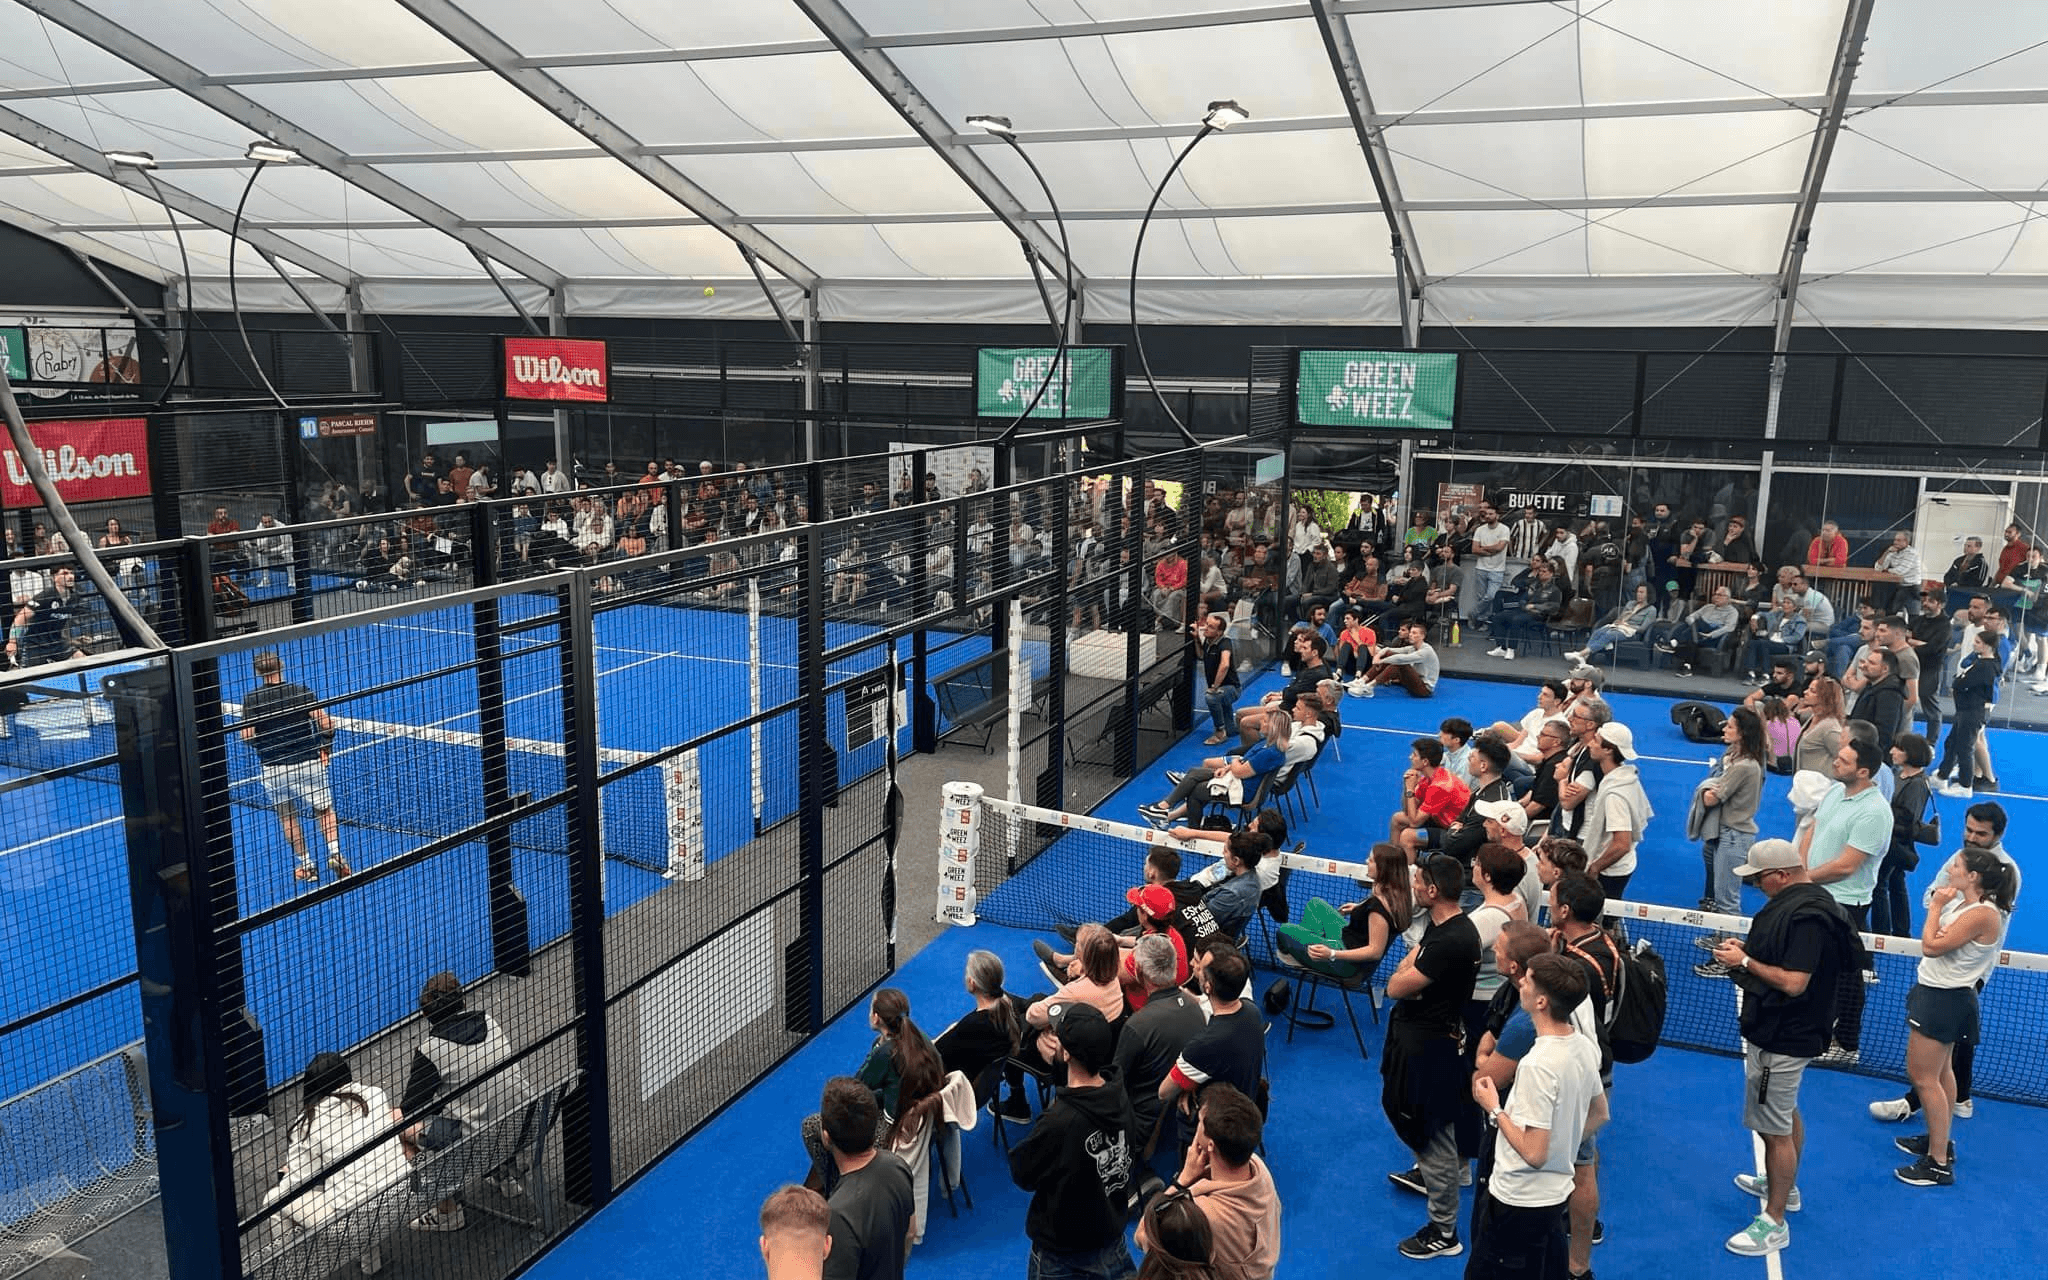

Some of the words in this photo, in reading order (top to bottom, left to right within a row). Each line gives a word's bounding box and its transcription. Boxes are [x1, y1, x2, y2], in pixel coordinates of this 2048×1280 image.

[512, 355, 604, 387] Wilson
[1344, 361, 1416, 389] GREEN
[1352, 391, 1414, 419] WEEZ
[301, 420, 316, 437] 10
[331, 419, 353, 427] PASCAL
[1508, 493, 1566, 510] BUVETTE
[950, 828, 968, 837] GREEN
[947, 866, 965, 874] GREEN
